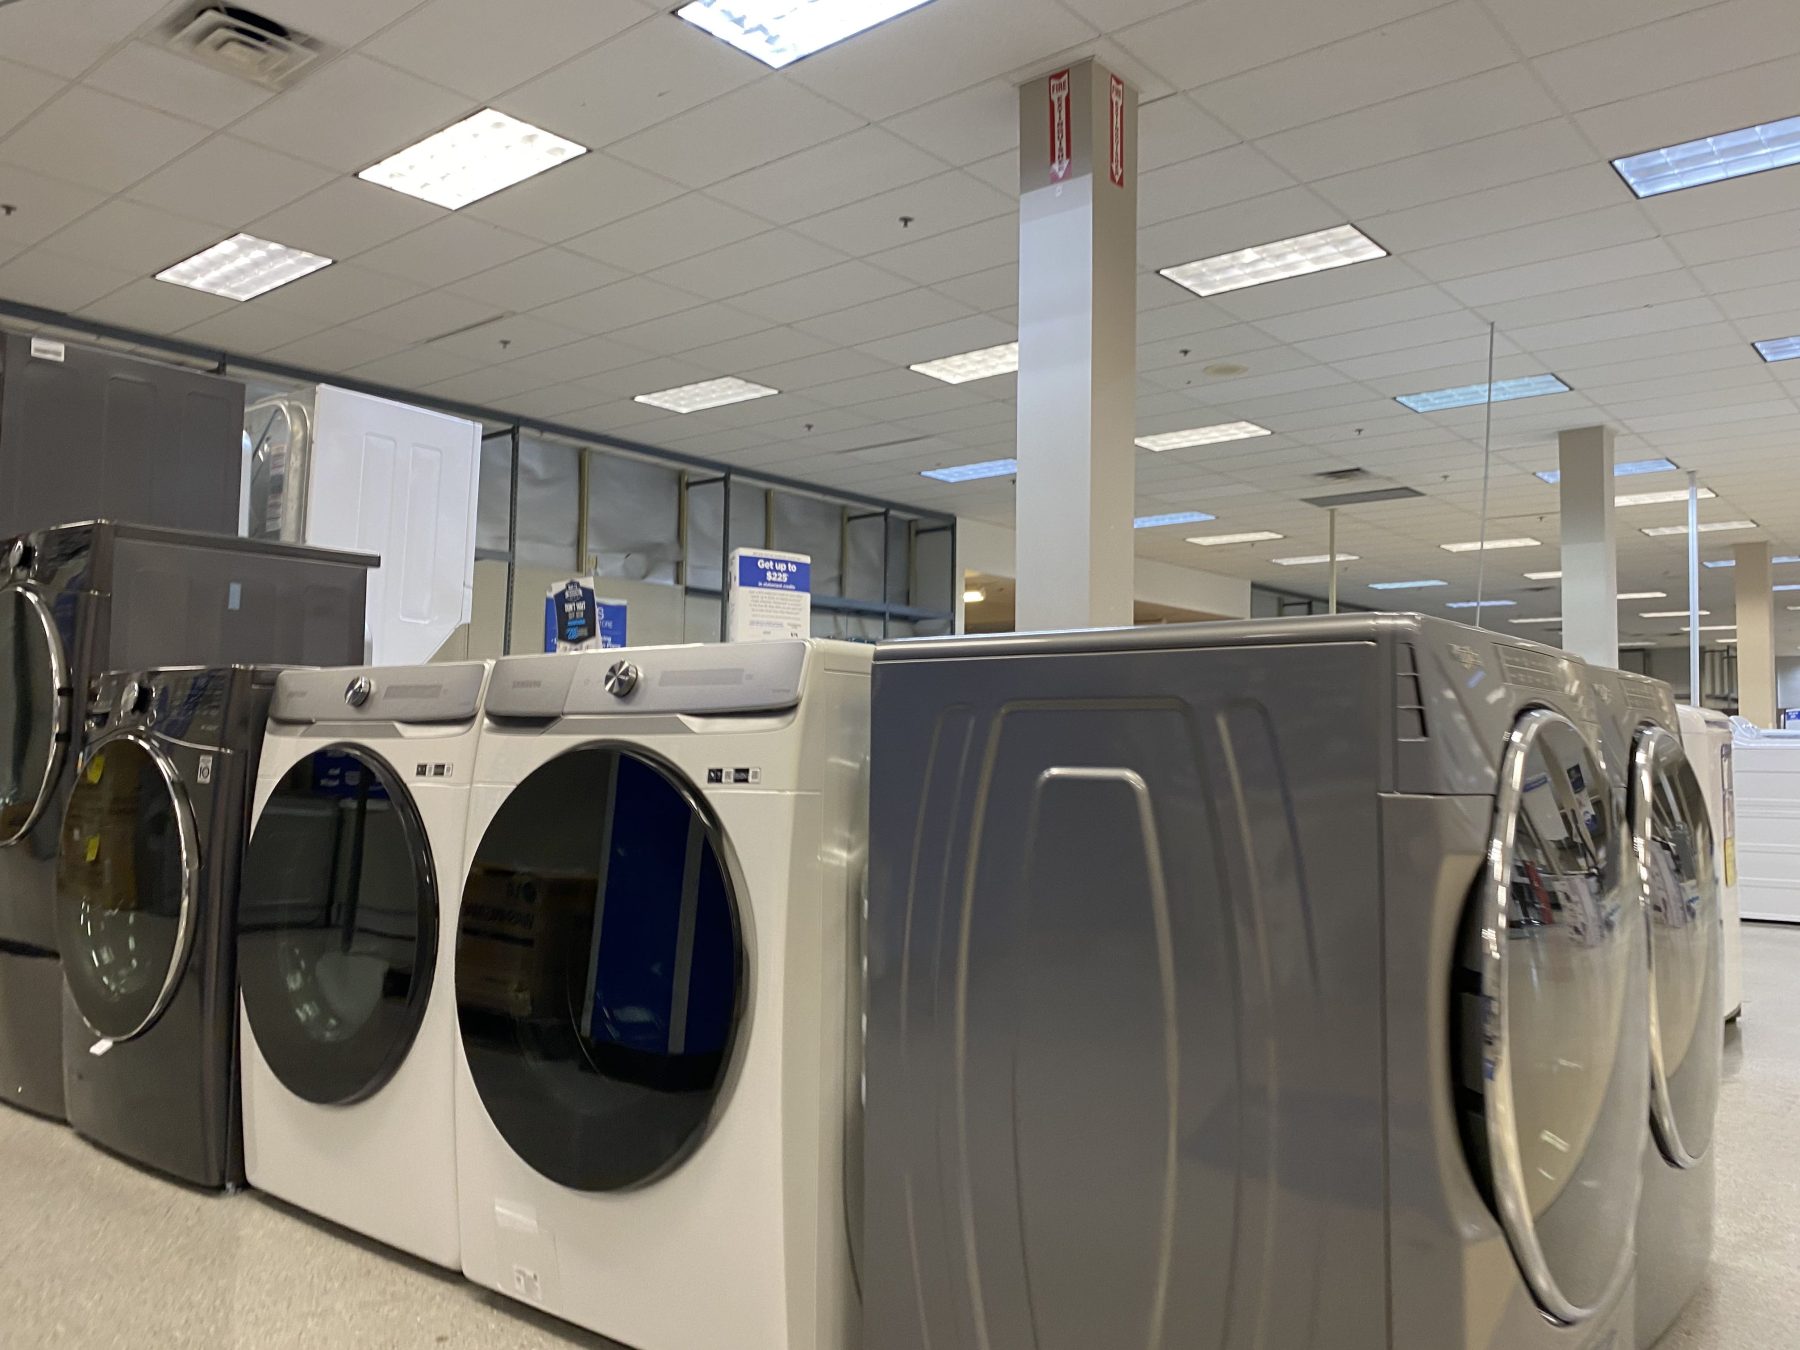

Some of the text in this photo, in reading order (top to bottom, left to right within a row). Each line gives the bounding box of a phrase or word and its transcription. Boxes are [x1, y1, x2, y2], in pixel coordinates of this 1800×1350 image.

[1051, 82, 1067, 94] FIRE
[758, 559, 797, 573] Get up to
